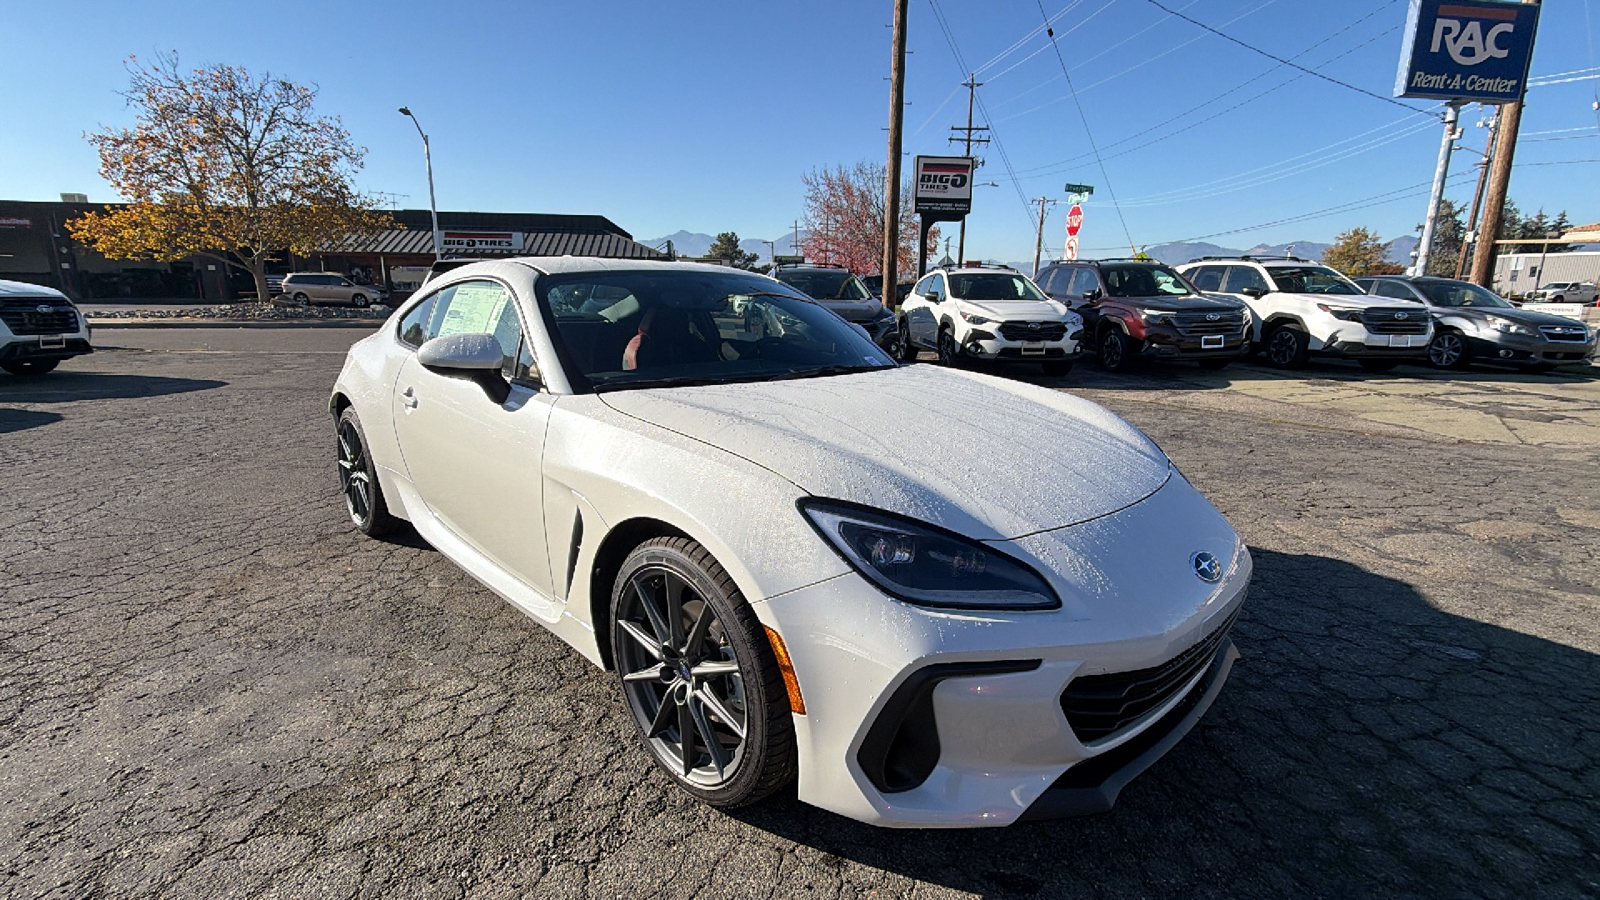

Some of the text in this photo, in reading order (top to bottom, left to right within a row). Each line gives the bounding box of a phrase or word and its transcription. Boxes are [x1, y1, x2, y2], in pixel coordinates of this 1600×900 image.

[1430, 18, 1514, 66] RAC
[920, 173, 967, 188] BIG O
[1067, 215, 1082, 227] STOP
[466, 239, 476, 247] O
[477, 239, 513, 247] TIRES
